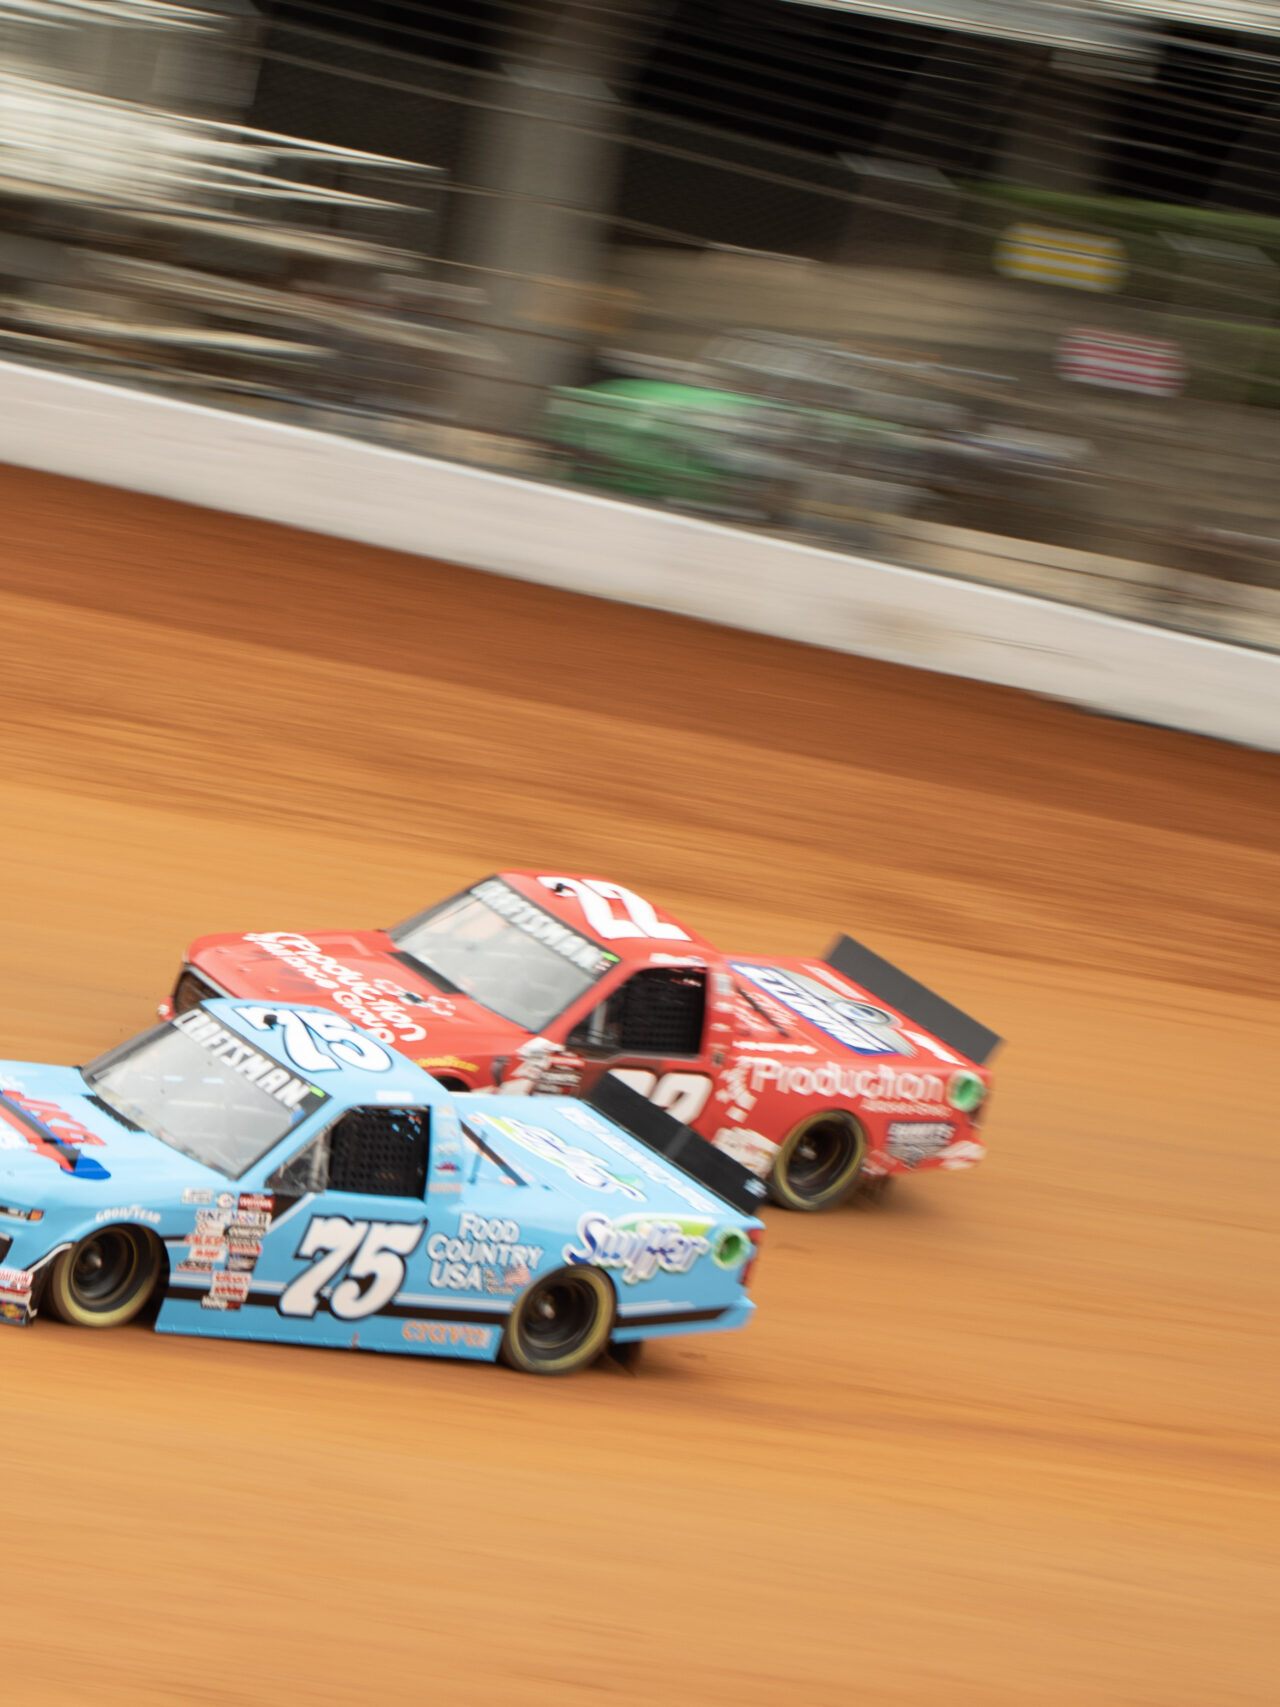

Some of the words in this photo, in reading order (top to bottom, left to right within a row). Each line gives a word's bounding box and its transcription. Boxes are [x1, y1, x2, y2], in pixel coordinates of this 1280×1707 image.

[536, 875, 692, 940] 22
[278, 938, 428, 1043] Production
[171, 1008, 312, 1108] CRAFTSMAN
[231, 1005, 394, 1073] 75
[747, 1058, 946, 1103] Production
[426, 1232, 545, 1271] COUNTRY
[457, 1212, 521, 1244] FOOD
[278, 1214, 428, 1322] 75
[429, 1260, 484, 1292] USA
